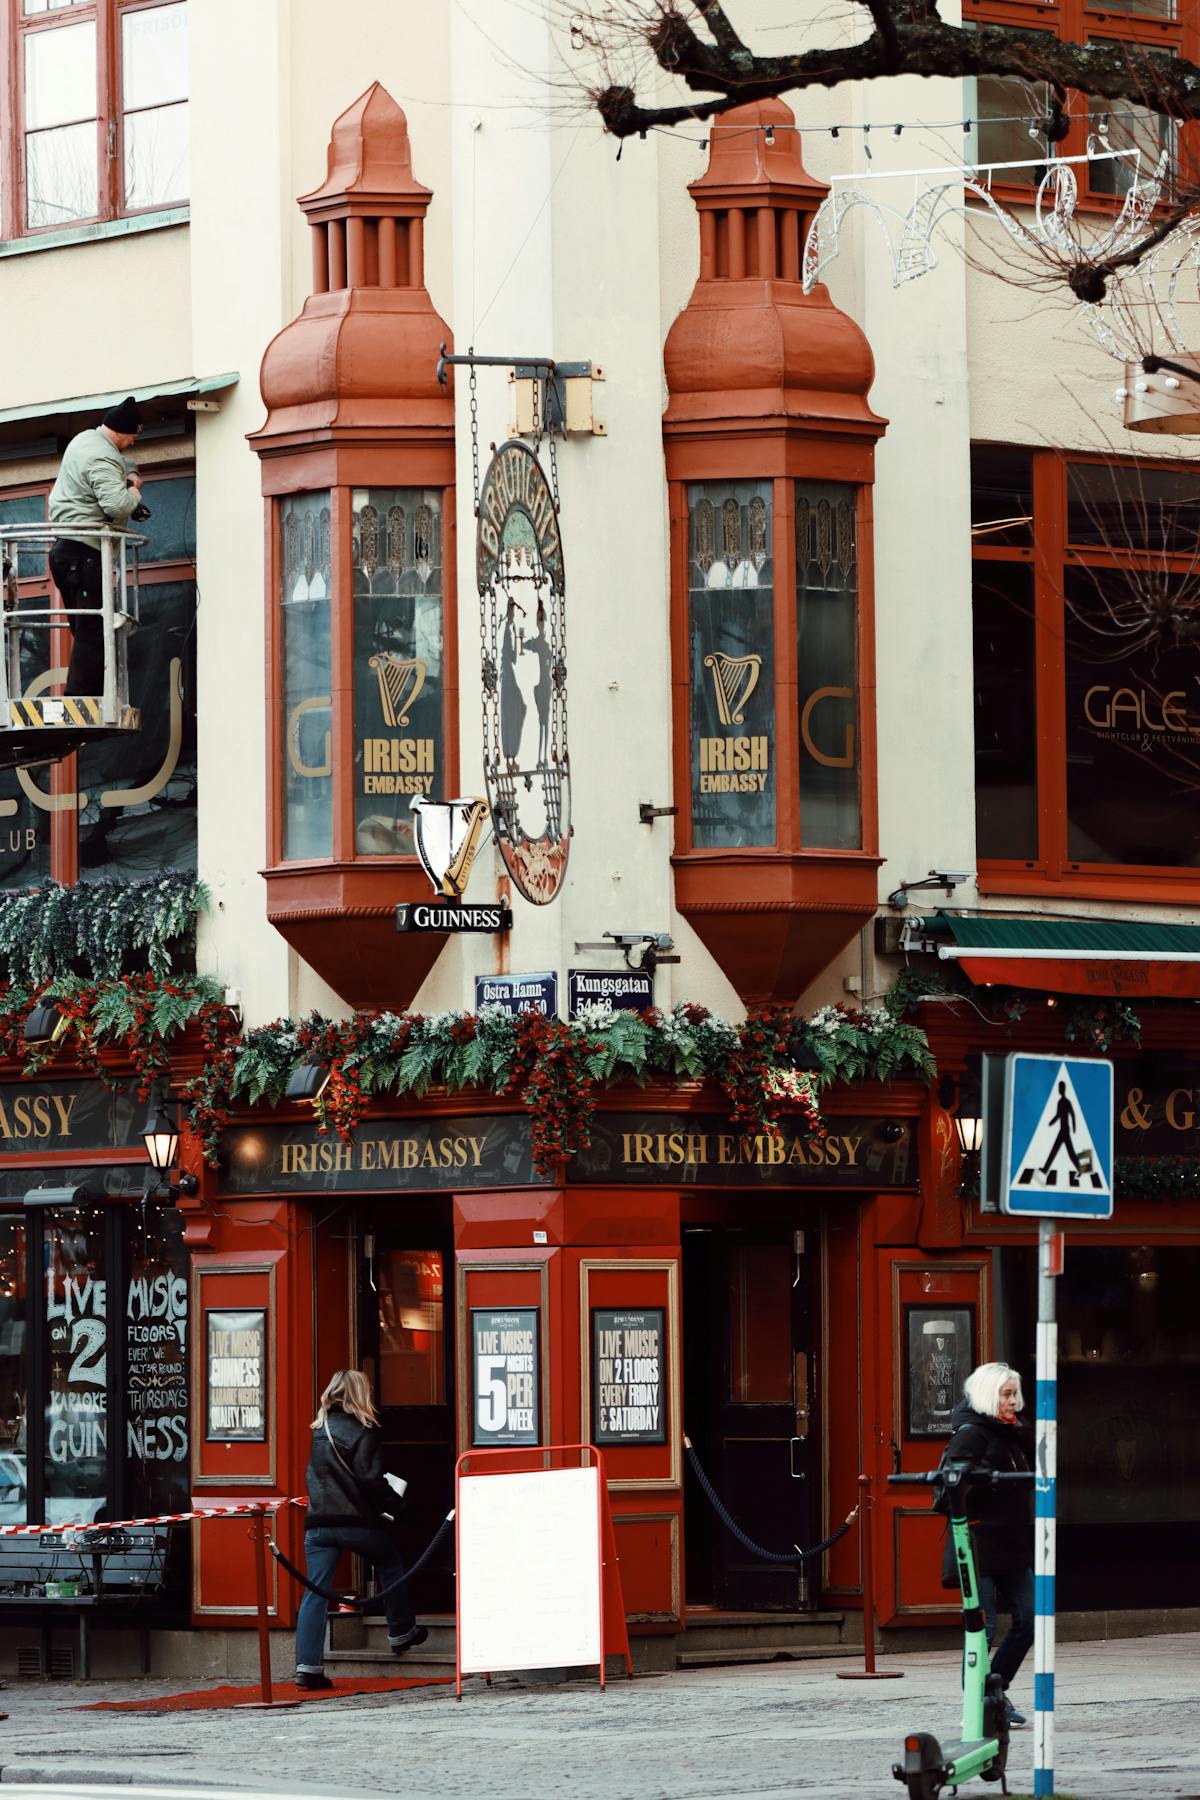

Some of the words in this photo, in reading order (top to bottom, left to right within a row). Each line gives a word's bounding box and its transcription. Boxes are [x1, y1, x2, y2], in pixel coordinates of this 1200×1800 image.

[1084, 685, 1200, 733] GALE
[801, 686, 854, 768] G
[364, 738, 435, 773] IRISH
[700, 736, 768, 772] IRISH
[364, 775, 434, 794] EMBASSY
[700, 773, 768, 794] EMBASSY
[0, 828, 36, 852] UB
[414, 907, 500, 928] GUINNESS
[483, 980, 511, 1000] Östra
[512, 982, 547, 999] Hamn-
[576, 974, 649, 997] Kungsgatan
[1120, 1087, 1153, 1130] &
[1165, 1088, 1200, 1131] G
[280, 1142, 352, 1174] IRISH
[360, 1136, 488, 1171] EMBASSY
[621, 1133, 708, 1164] IRISH
[717, 1135, 862, 1166] EMBASSY
[47, 1268, 107, 1327] LIVE
[127, 1268, 188, 1324] MUSIC
[51, 1327, 66, 1340] ON
[67, 1318, 107, 1388] 2
[212, 1330, 229, 1357] LIVE
[231, 1330, 260, 1357] MUSIC
[478, 1331, 499, 1354] LIVE
[501, 1331, 533, 1354] MUSIC
[600, 1330, 622, 1358] LIVE
[624, 1330, 659, 1358] MUSIC
[211, 1358, 260, 1387] GUINNESS
[600, 1359, 613, 1384] ON
[614, 1359, 623, 1384] 2
[623, 1358, 659, 1384] FLOORS
[929, 1375, 953, 1386] NAME
[50, 1390, 107, 1413] KARAOKE
[127, 1389, 188, 1411] THURSDAYS
[478, 1355, 507, 1432] 5
[507, 1355, 533, 1372] NIGHTS
[507, 1373, 533, 1408] PER
[600, 1384, 627, 1407] EVERY
[628, 1383, 659, 1406] FRIDAY
[211, 1406, 240, 1427] QUALITY
[241, 1406, 260, 1427] FOOD
[508, 1409, 534, 1431] WEEK
[609, 1407, 659, 1431] SATURDAY
